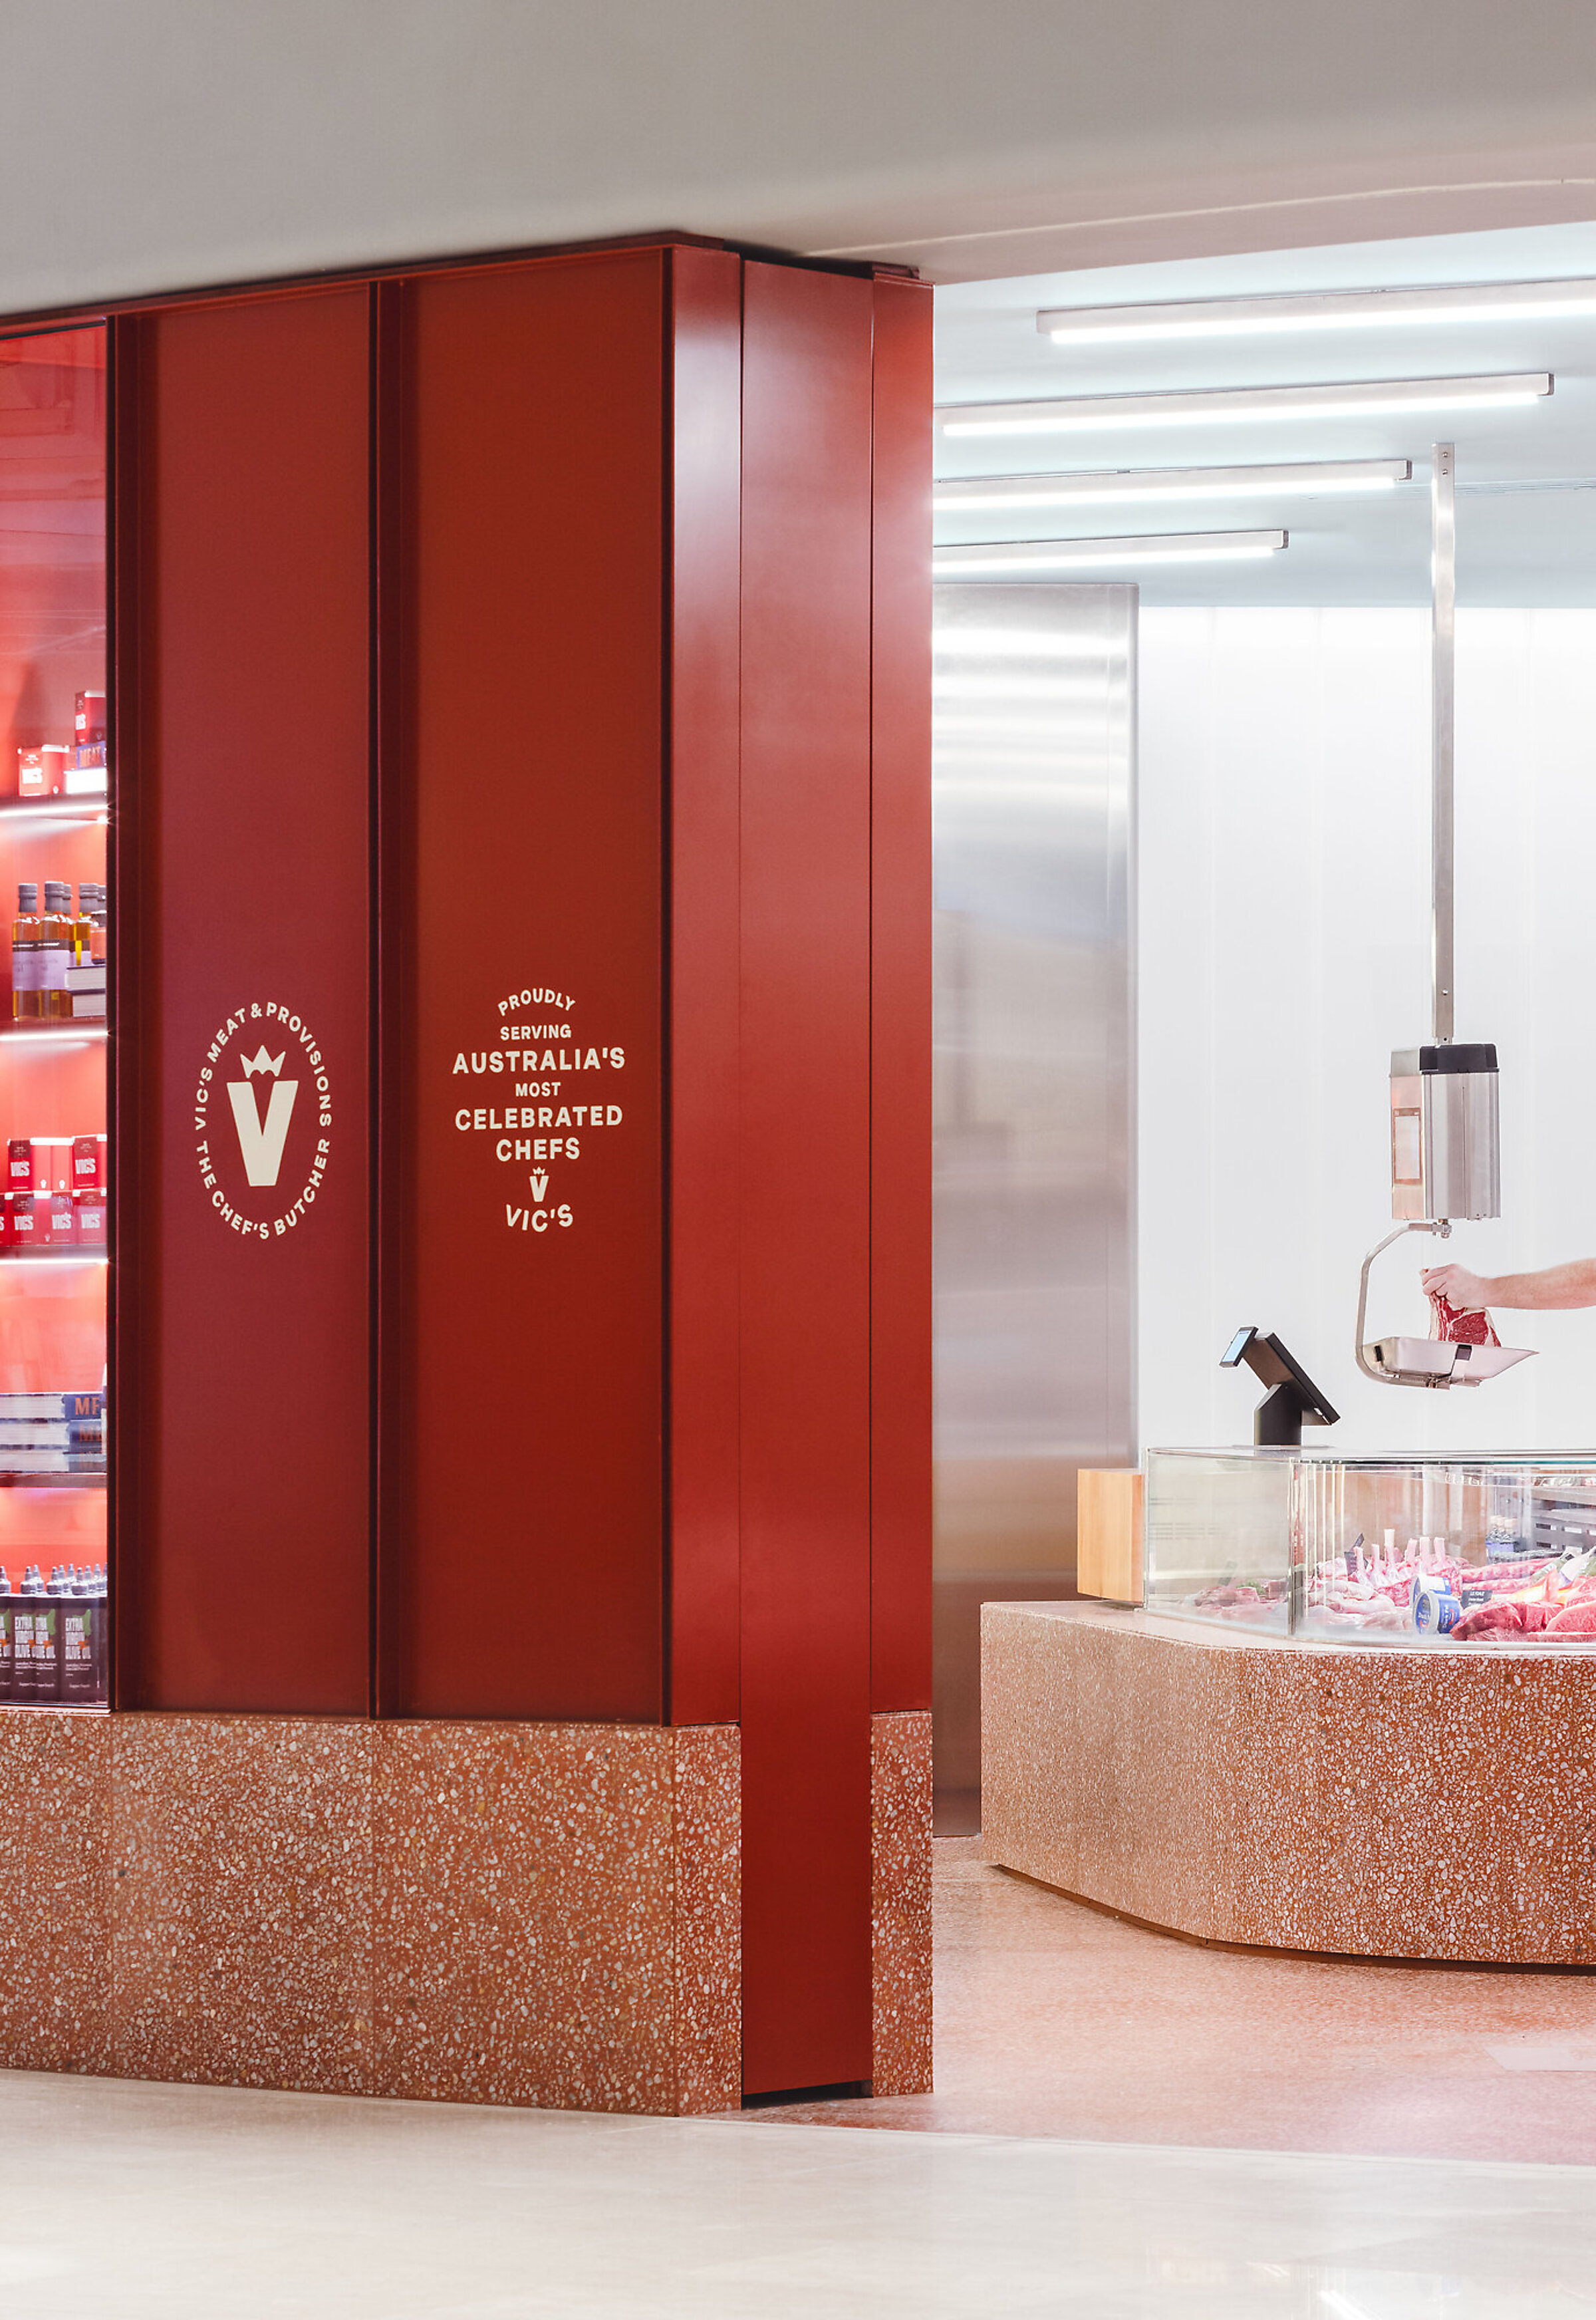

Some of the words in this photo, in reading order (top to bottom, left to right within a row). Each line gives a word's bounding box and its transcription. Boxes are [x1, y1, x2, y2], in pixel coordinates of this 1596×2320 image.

[498, 988, 575, 1016] PROUDLY
[501, 1024, 571, 1040] SERVING
[195, 1068, 212, 1130] VIC'S
[207, 1008, 245, 1062] MEAT
[251, 1003, 262, 1018] &
[267, 1002, 331, 1126] PROVISIONS
[453, 1048, 624, 1074] AUSTRALIA'S
[516, 1082, 561, 1097] MOST
[456, 1105, 622, 1130] CELEBRATED
[496, 1137, 579, 1161] CHEFS
[197, 1141, 216, 1189] THE
[212, 1191, 269, 1239] CHEF'S
[274, 1139, 329, 1235] BUTCHER
[506, 1205, 573, 1232] VIC'S
